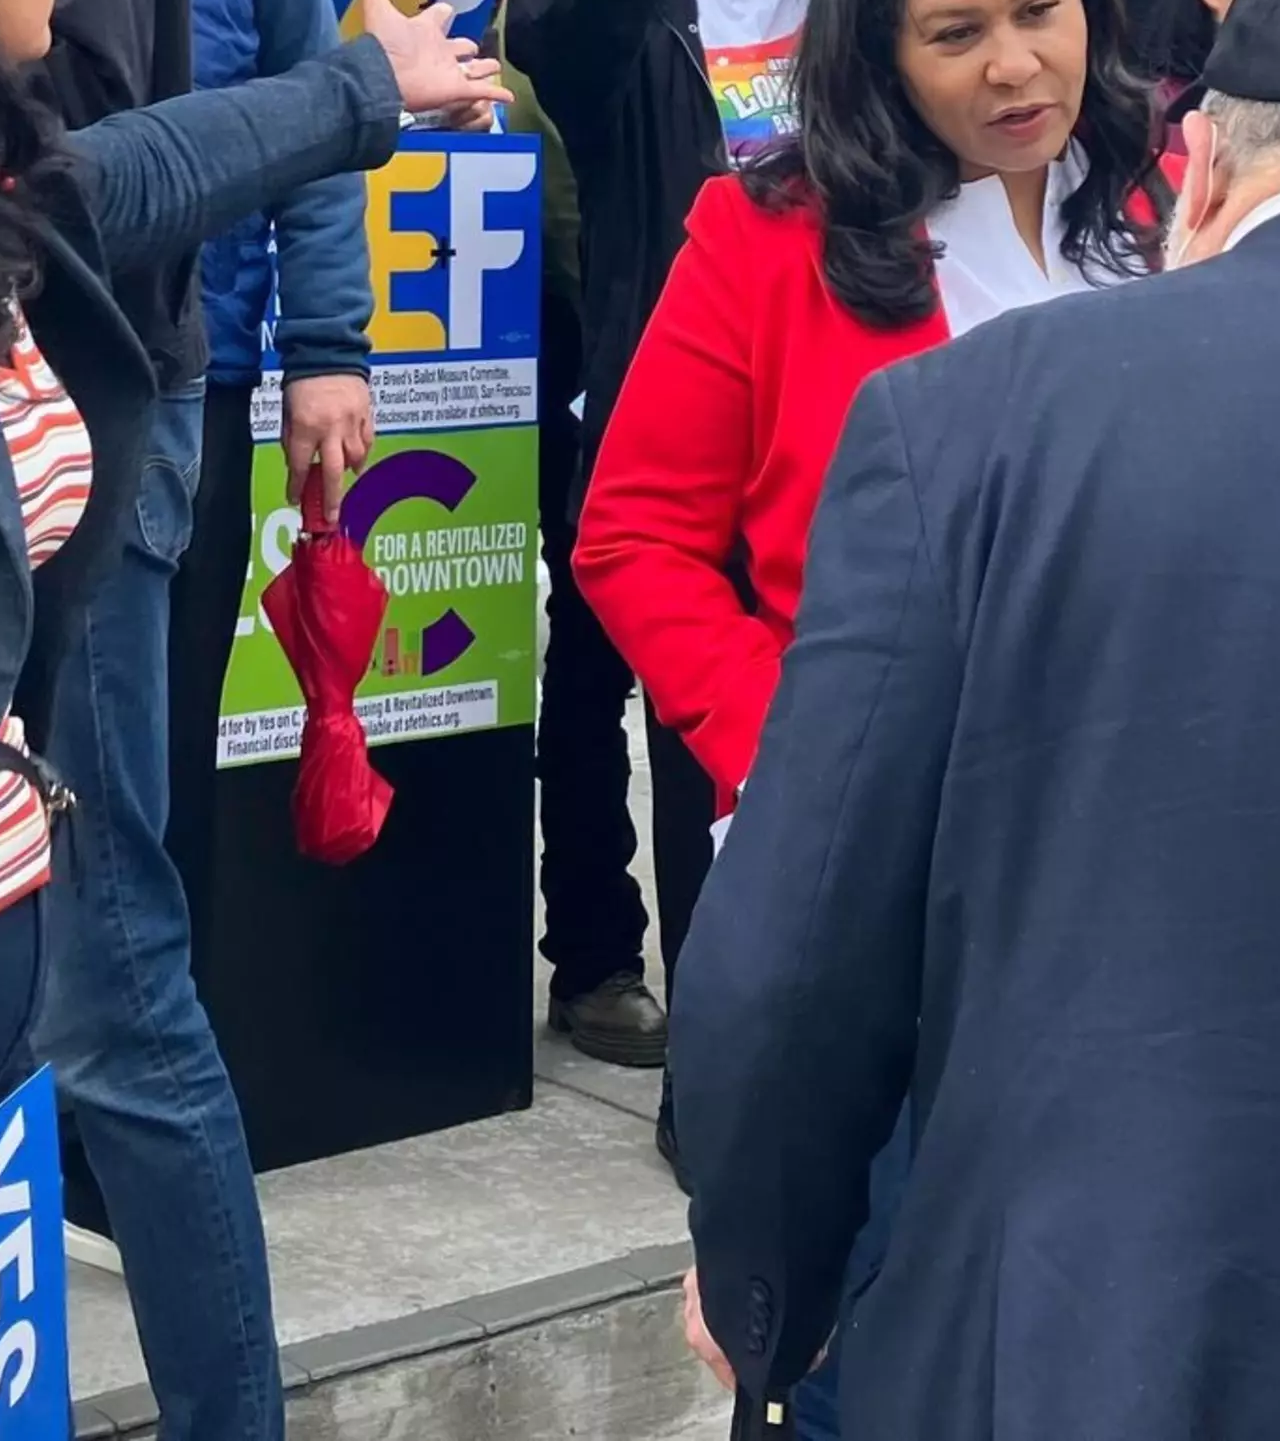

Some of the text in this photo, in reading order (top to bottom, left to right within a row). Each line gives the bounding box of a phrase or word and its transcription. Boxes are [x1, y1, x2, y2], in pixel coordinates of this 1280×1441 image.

[374, 522, 527, 562] FOR A REVITALIZED
[375, 552, 524, 597] DOWNTOWN
[393, 691, 444, 712] Revitalized
[227, 720, 243, 735] for
[244, 718, 257, 737] by
[258, 716, 275, 731] Yes
[276, 717, 290, 728] on
[393, 718, 403, 733] at
[227, 737, 271, 757] Financial
